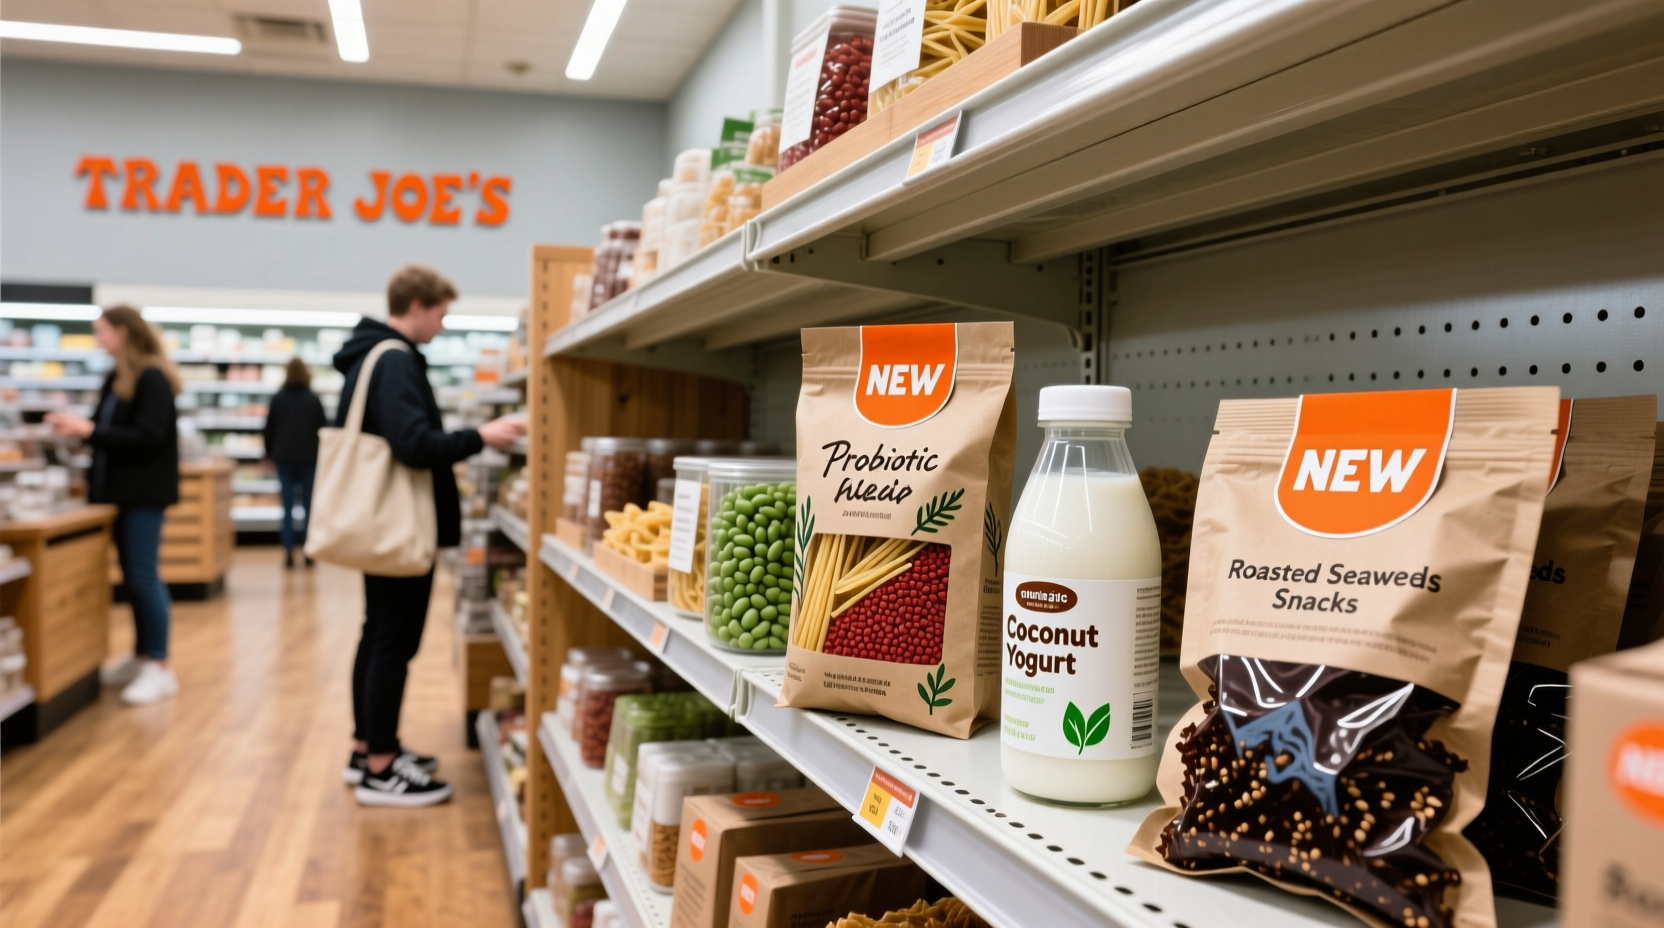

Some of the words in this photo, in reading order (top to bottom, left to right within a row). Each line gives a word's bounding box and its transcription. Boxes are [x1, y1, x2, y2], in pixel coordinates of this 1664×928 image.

[76, 155, 332, 219] TRADER
[353, 170, 513, 226] JOE'S
[865, 363, 946, 396] NEW
[821, 440, 939, 478] Probiotic
[1292, 447, 1428, 493] NEW
[1228, 559, 1322, 584] Roasted
[1326, 562, 1442, 593] Seaweds
[1271, 588, 1358, 614] Snacks
[1006, 614, 1099, 648] Coconut
[1006, 642, 1077, 678] Yogurt
